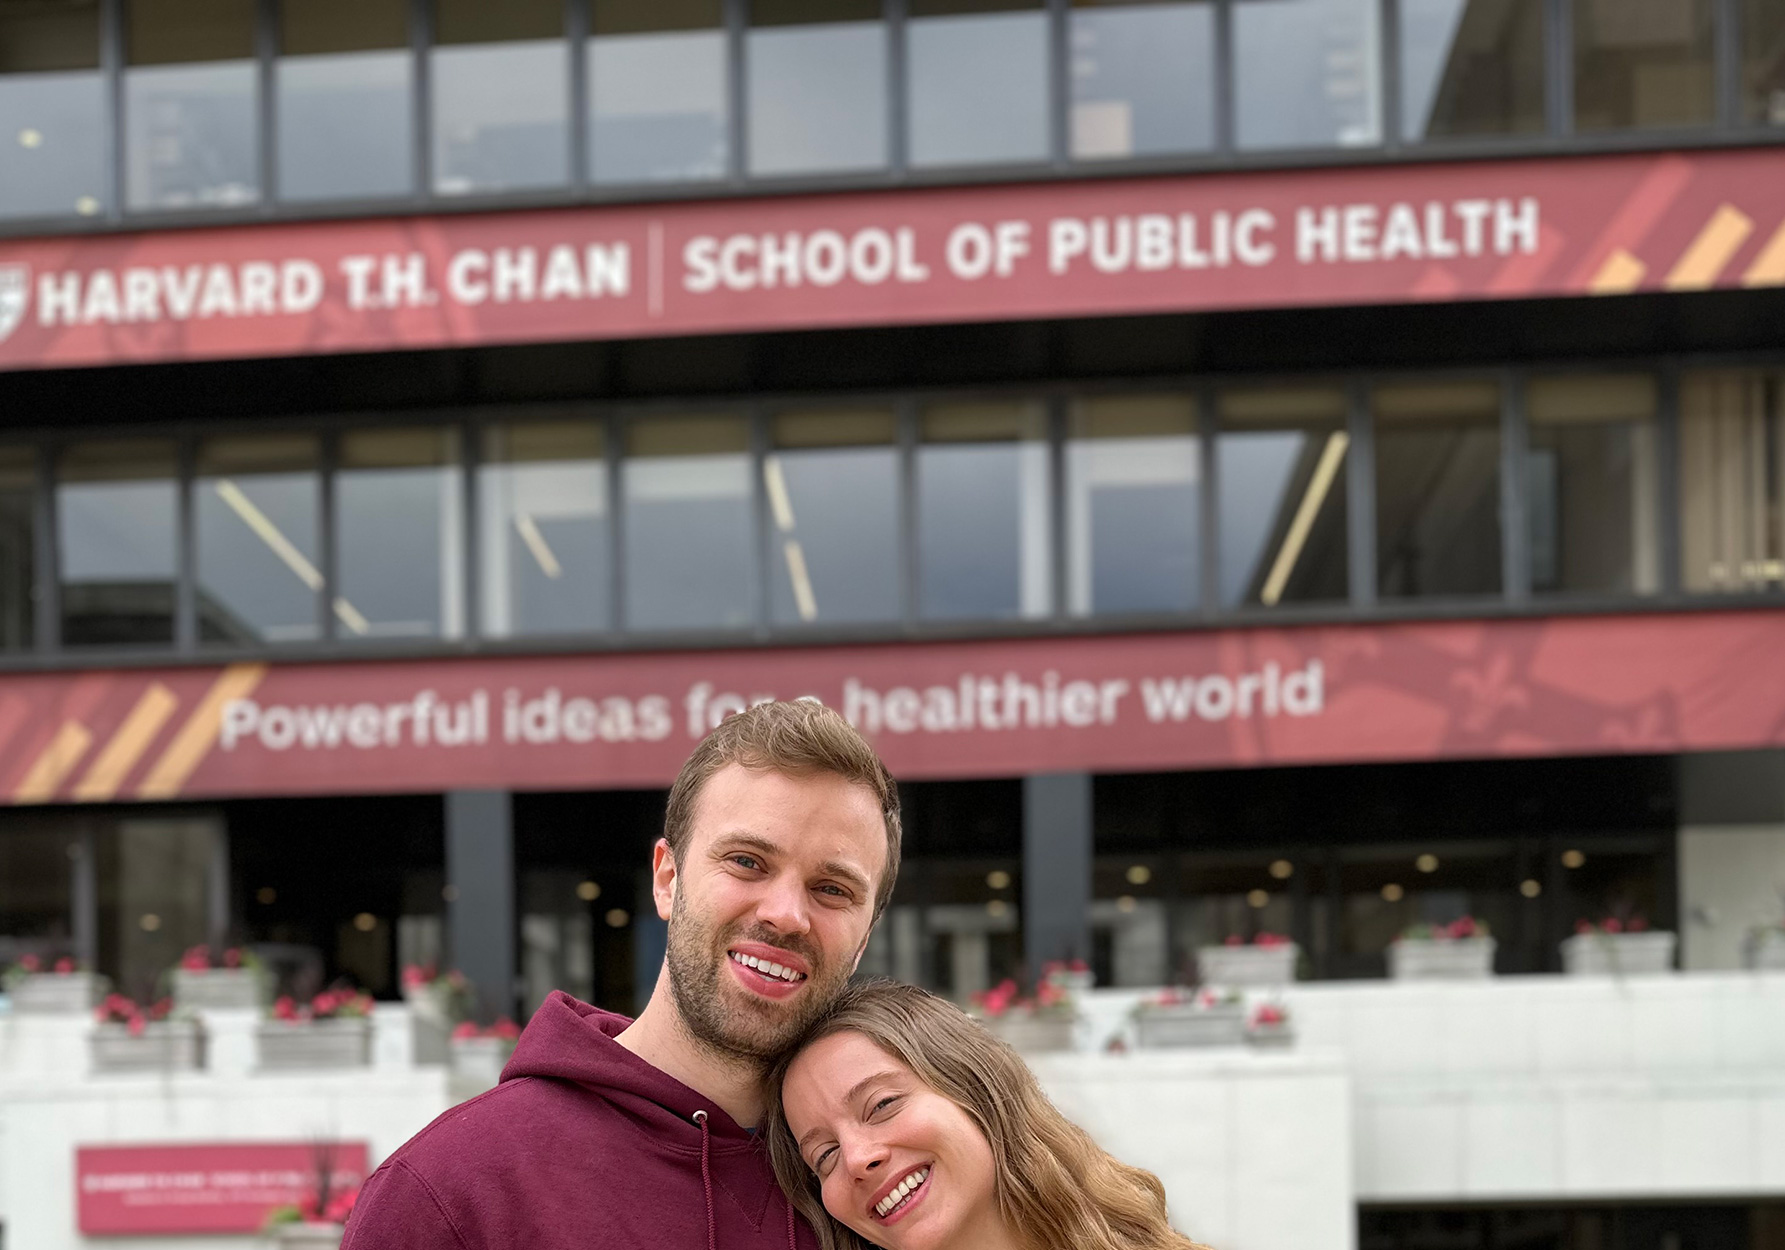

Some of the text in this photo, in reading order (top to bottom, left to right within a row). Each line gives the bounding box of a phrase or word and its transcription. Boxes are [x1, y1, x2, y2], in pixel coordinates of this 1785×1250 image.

[37, 197, 1540, 326] HARVARD T.H. CHAN SCHOOL OF PUBLIC HEALTH
[219, 687, 490, 751] Powerful
[502, 687, 673, 744] ideas
[843, 668, 1129, 736] healthier
[1139, 659, 1326, 722] world
